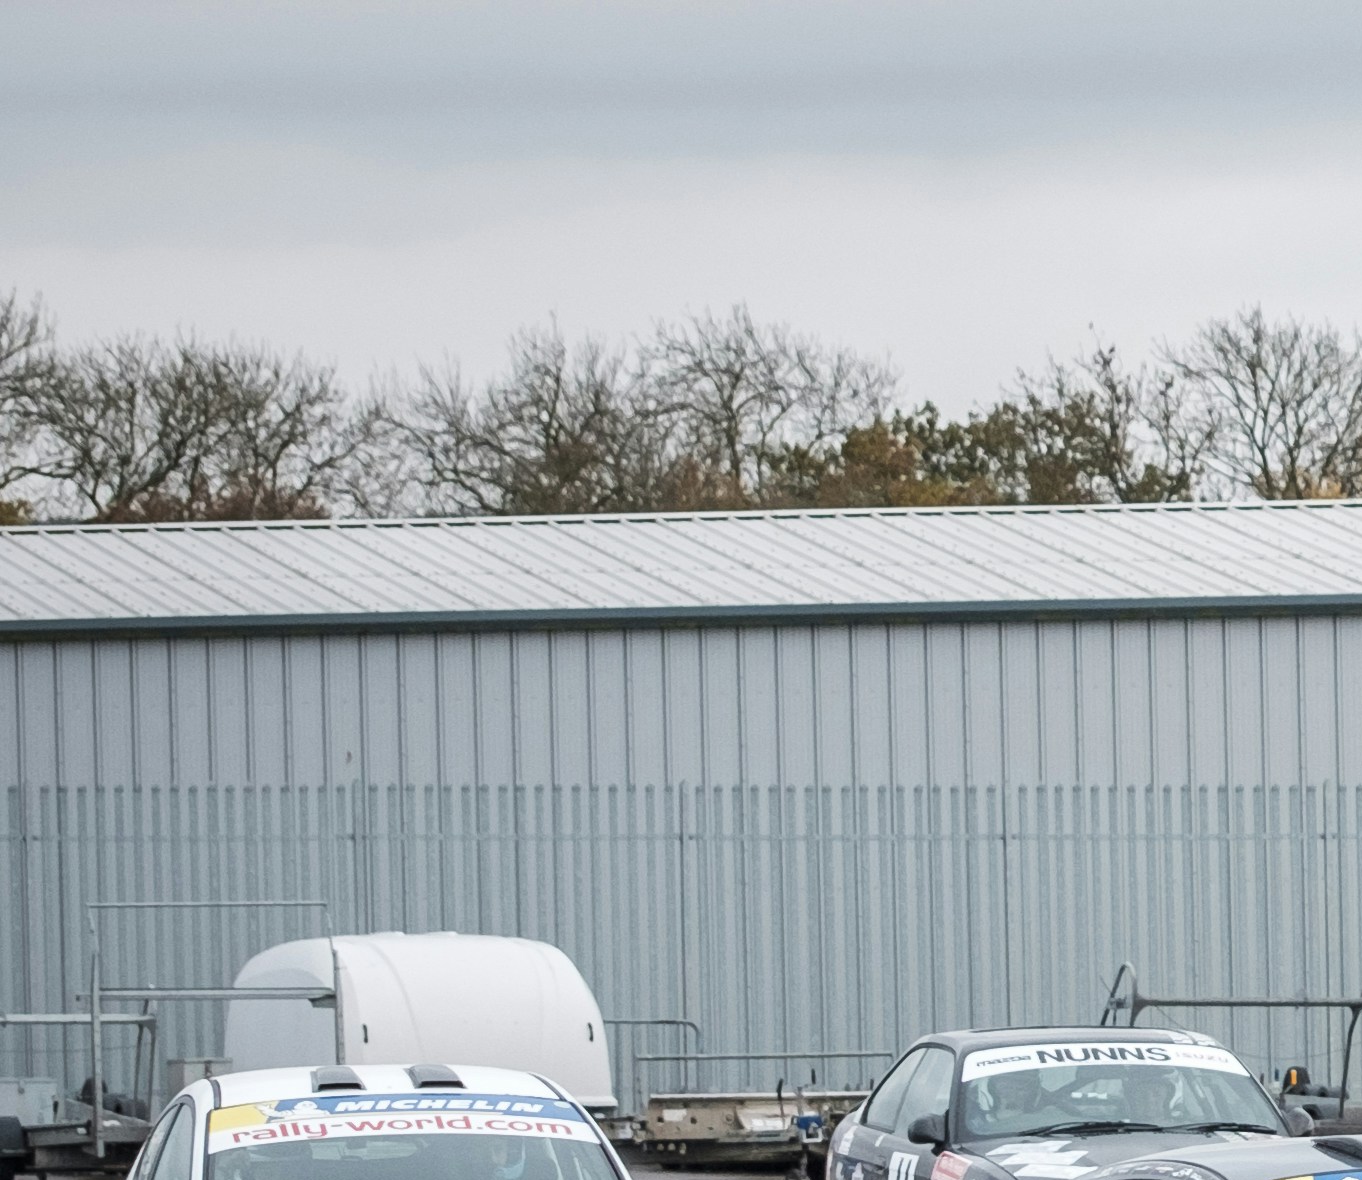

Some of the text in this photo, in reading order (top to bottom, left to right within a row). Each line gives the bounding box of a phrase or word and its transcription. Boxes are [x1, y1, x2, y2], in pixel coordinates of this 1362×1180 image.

[1036, 1047, 1171, 1064] NUNNS
[335, 1098, 544, 1113] MICHELIN
[232, 1115, 573, 1143] rally-world.com
